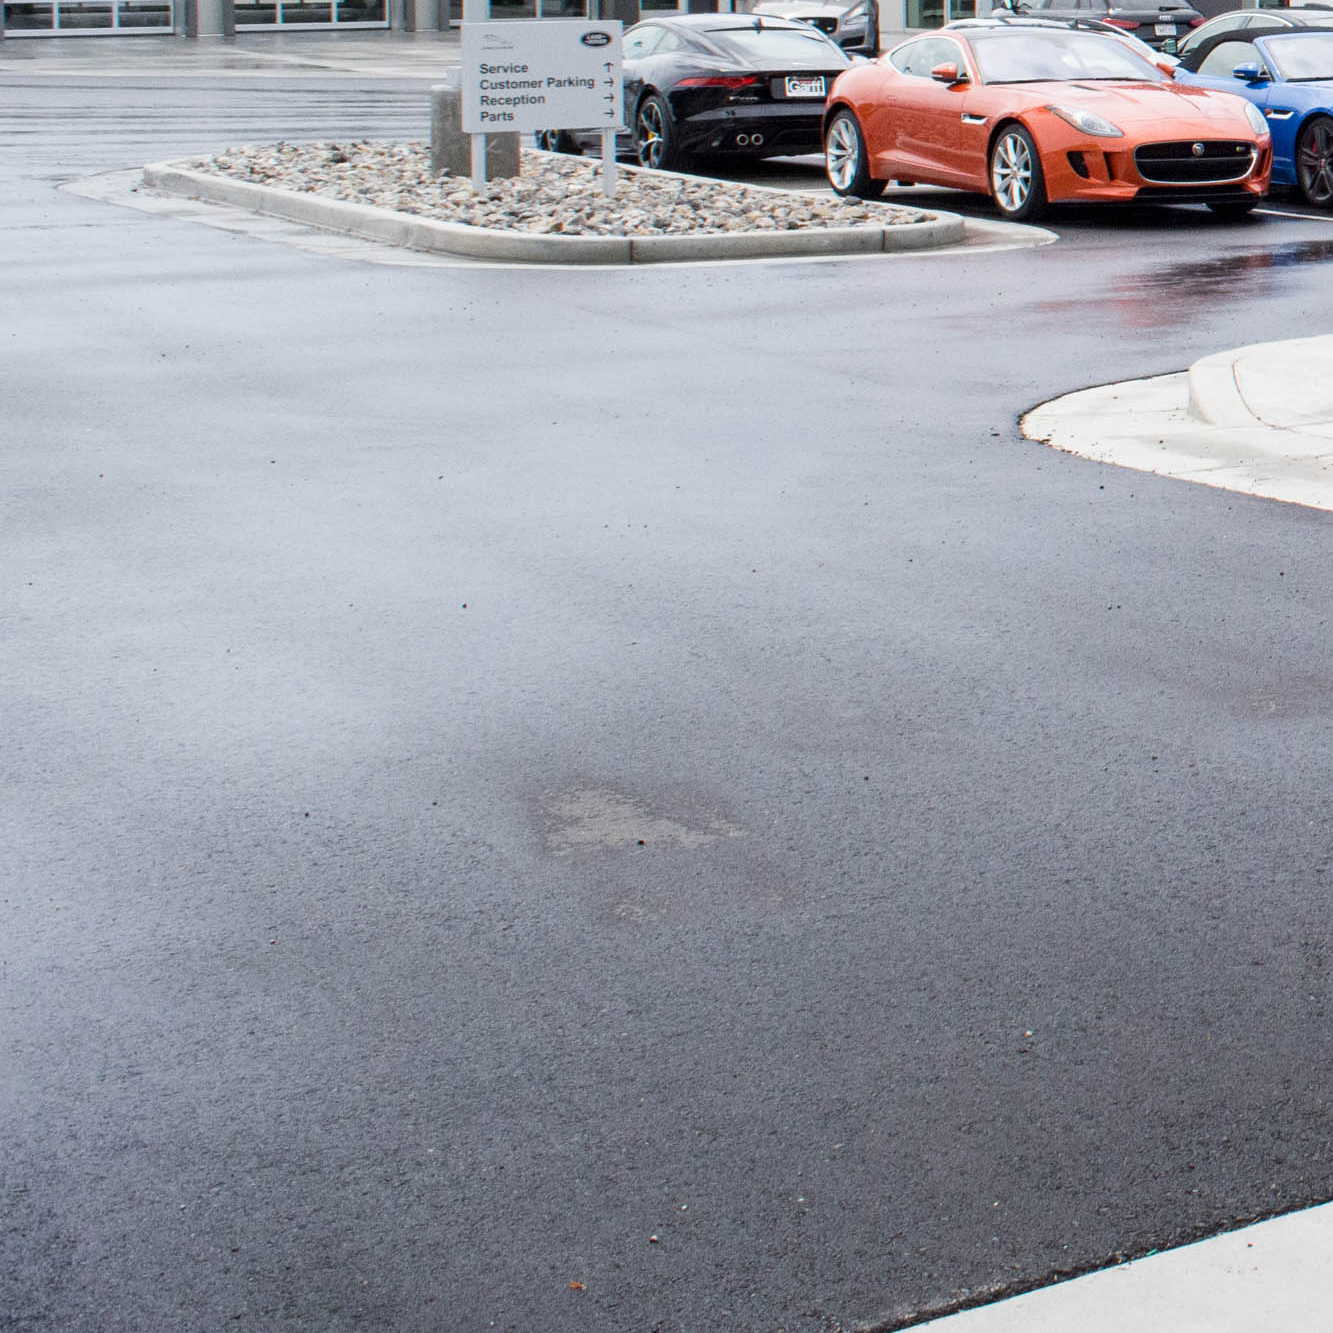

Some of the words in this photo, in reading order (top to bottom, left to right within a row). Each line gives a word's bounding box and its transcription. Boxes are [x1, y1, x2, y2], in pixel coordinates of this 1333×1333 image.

[480, 63, 528, 74] Service
[480, 79, 543, 90] Customer
[547, 77, 595, 89] Parking
[480, 94, 545, 107] Reception
[480, 111, 514, 122] Parts
